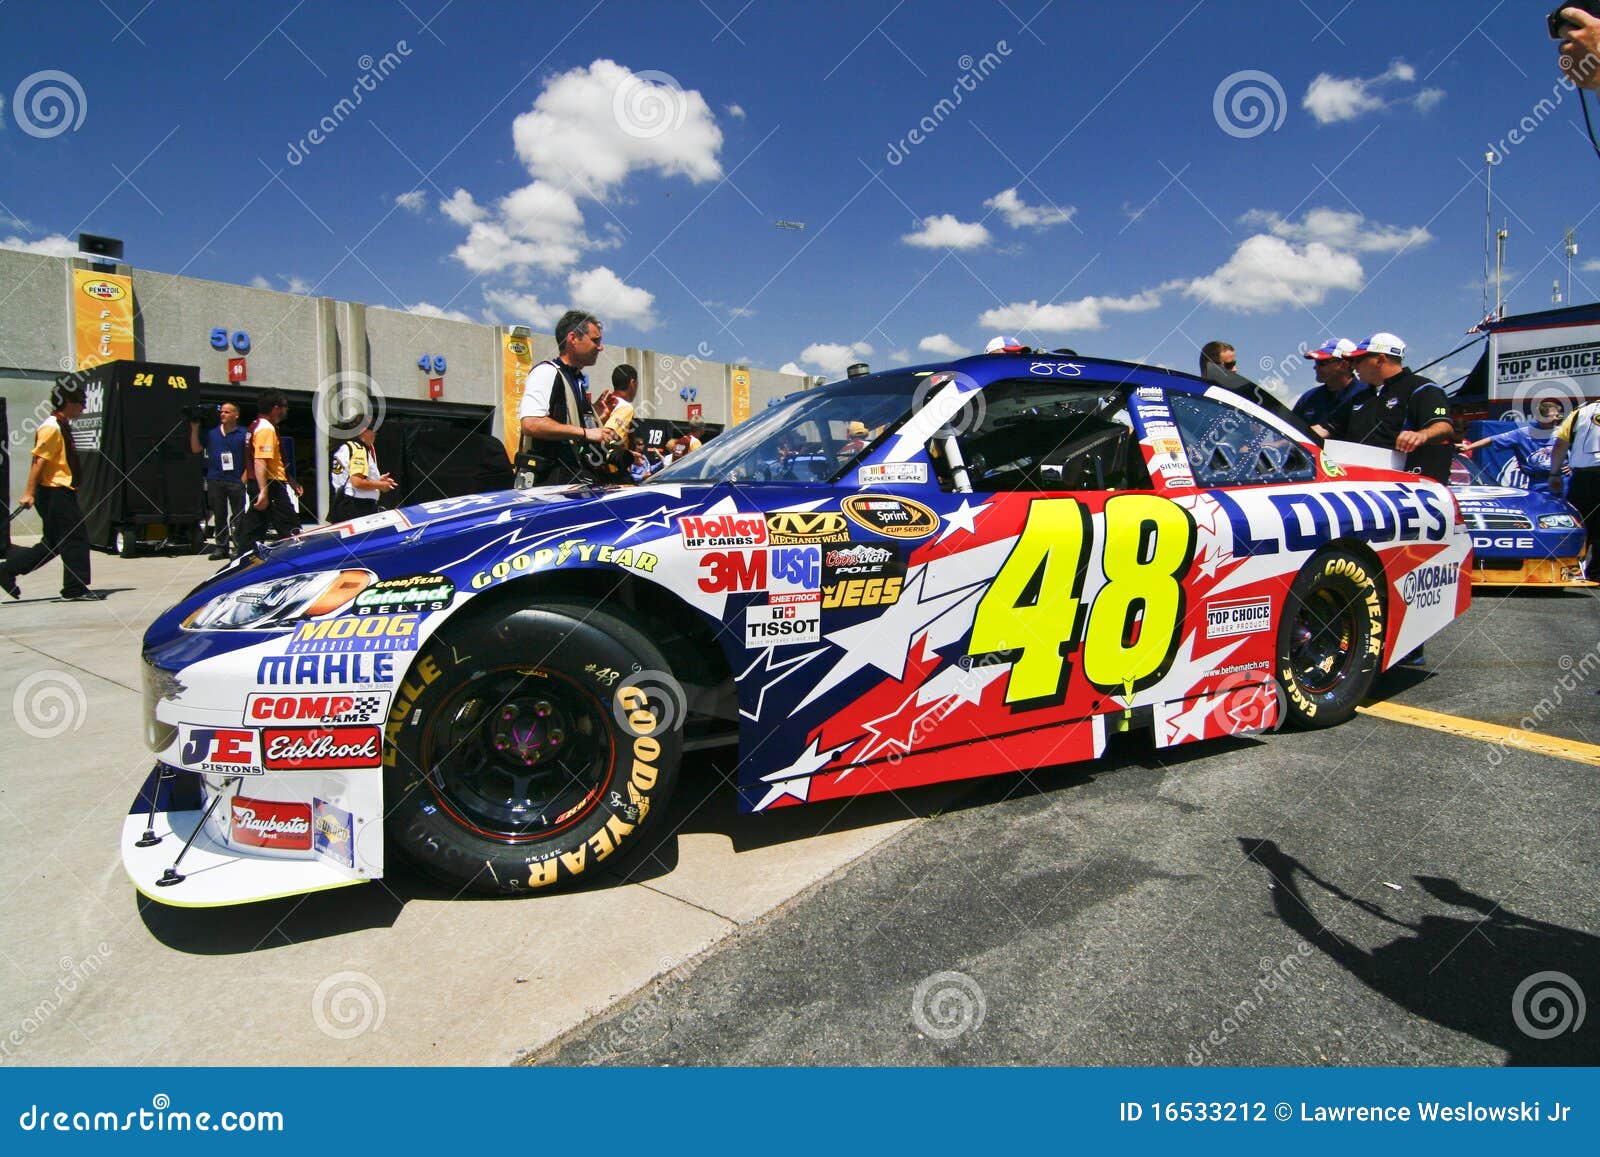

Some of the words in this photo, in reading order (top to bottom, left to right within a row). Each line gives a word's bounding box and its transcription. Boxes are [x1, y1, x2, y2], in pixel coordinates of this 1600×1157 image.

[89, 286, 119, 294] PENNZOIL
[100, 309, 113, 356] FEEL
[210, 328, 251, 352] 50
[417, 354, 447, 374] 49
[1498, 360, 1532, 376] TOP
[133, 373, 153, 387] 24
[168, 376, 188, 390] 48
[1434, 407, 1447, 416] 48
[649, 429, 663, 445] 18
[876, 511, 909, 523] Sprint
[680, 514, 767, 544] Holley
[770, 533, 822, 545] MECHANIX
[821, 532, 851, 545] WEAR
[687, 539, 708, 547] HP
[709, 537, 754, 546] CARBS
[1473, 537, 1534, 549] DGE
[470, 538, 661, 590] GOODYEAR
[771, 547, 821, 590] USG
[826, 550, 859, 567] Coors
[858, 551, 893, 564] LIGHT
[697, 549, 768, 594] 3M
[835, 565, 883, 575] POLE
[1417, 561, 1459, 592] KOBALT
[375, 575, 444, 588] GOODYEAR
[356, 584, 452, 606] Gatorback
[770, 593, 817, 603] SHEETROCK
[822, 576, 903, 609] JEGS
[967, 494, 1198, 711] 48
[1416, 588, 1442, 609] TOOLS
[358, 601, 444, 615] BELTS
[1208, 611, 1230, 625] TOP
[1232, 605, 1270, 622] CHOICE
[1324, 558, 1383, 657] GOODYEAR
[293, 614, 419, 643] MOOG
[748, 618, 819, 637] TISSOT
[292, 640, 354, 653] CHASSIS
[256, 652, 395, 685] MAHLE
[1203, 660, 1271, 678] www.bethematch.org
[1282, 666, 1318, 719] EAGLE
[251, 696, 356, 720] COMP
[384, 653, 443, 768] EAGLE
[319, 713, 371, 725] CAMS
[182, 729, 254, 765] JE
[266, 735, 378, 761] Edelbrock
[201, 762, 261, 775] PISTONS
[528, 686, 662, 889] GOODYEAR
[235, 808, 310, 837] Raybestos
